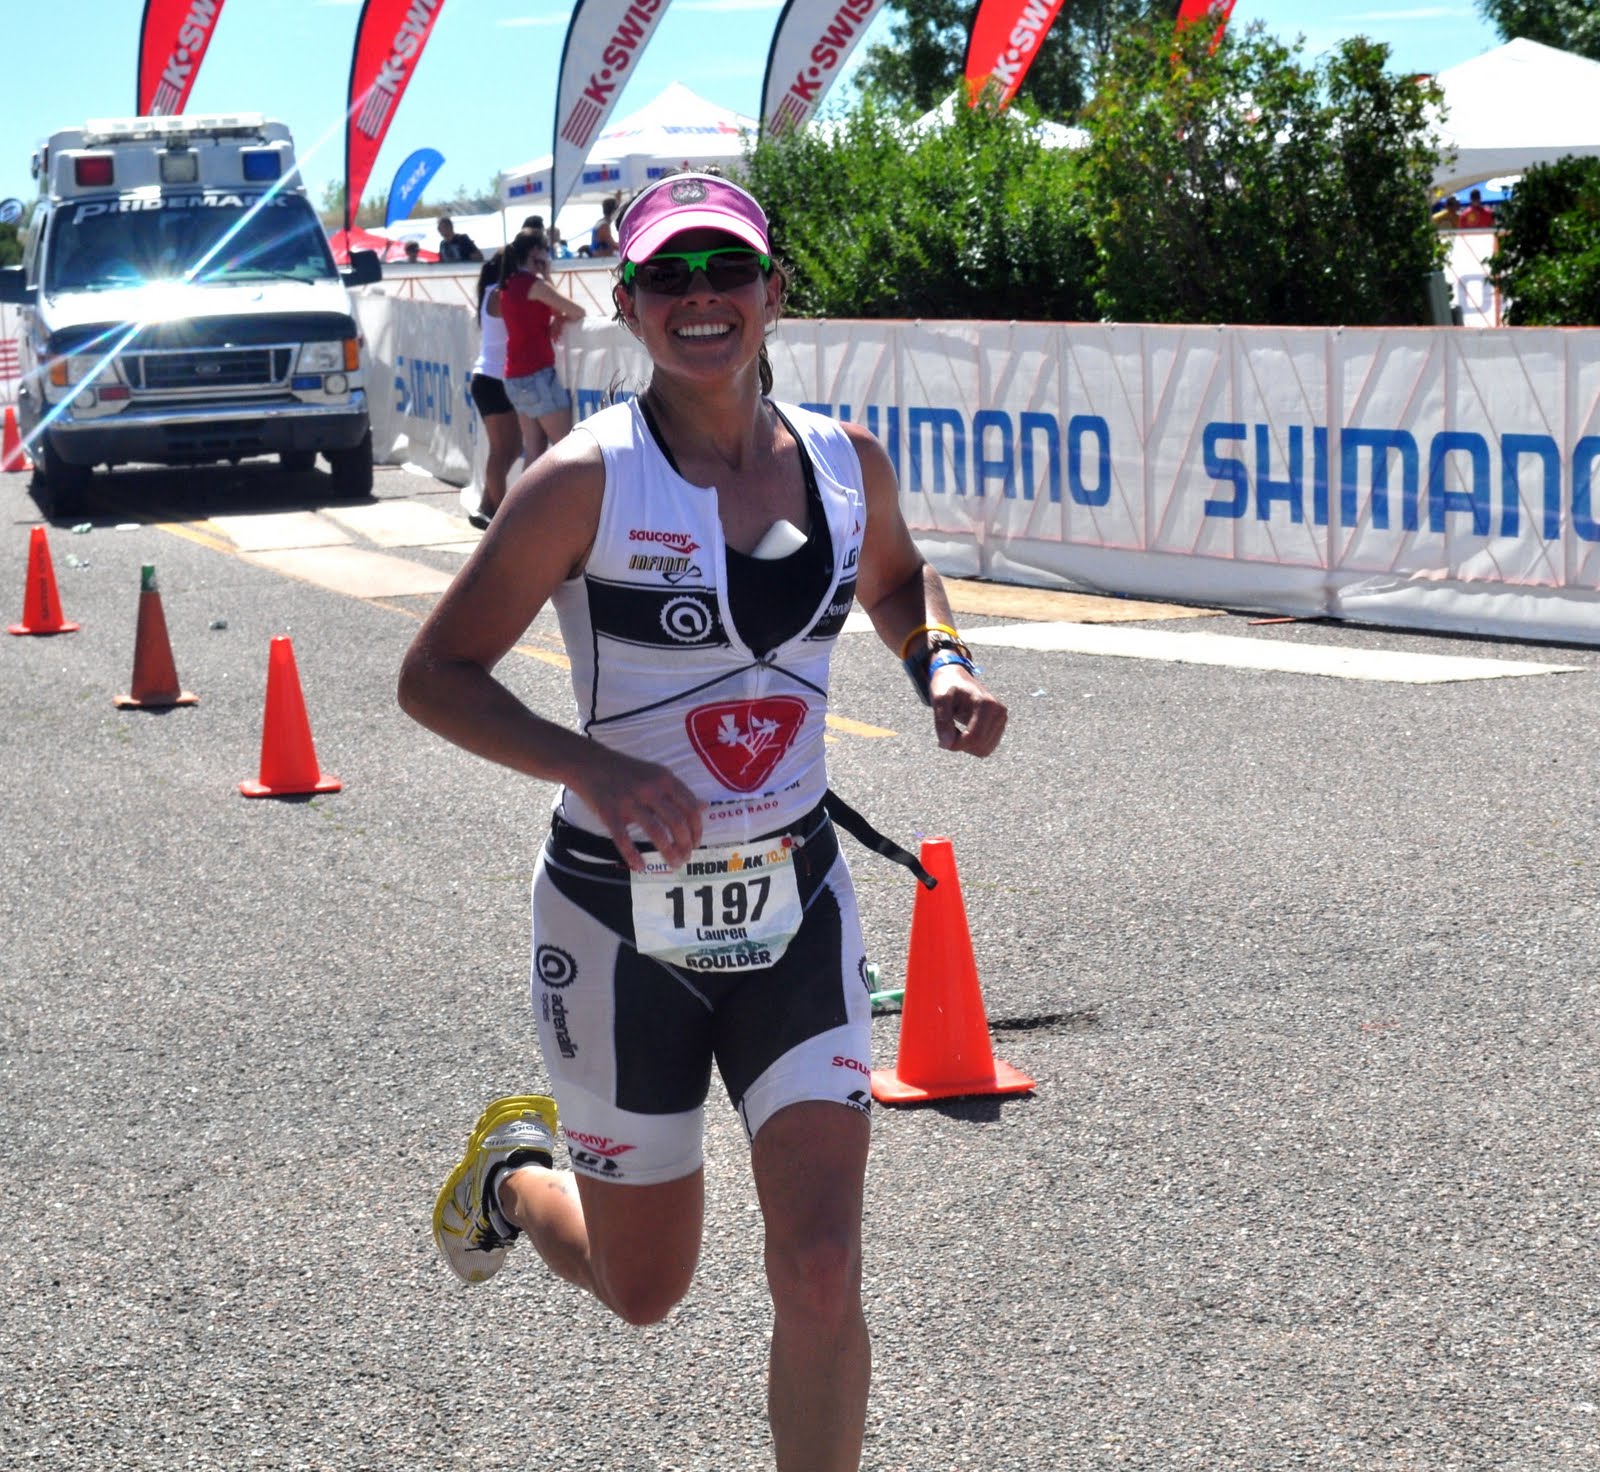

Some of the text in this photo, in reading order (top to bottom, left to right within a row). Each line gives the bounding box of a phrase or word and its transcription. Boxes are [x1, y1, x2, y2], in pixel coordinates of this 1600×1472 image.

[72, 195, 288, 225] PRIDEMARK
[799, 403, 1110, 506] IMANO
[629, 529, 688, 546] saucony
[665, 876, 771, 929] 1197
[696, 926, 748, 941] Lauren
[685, 950, 772, 970] BOULDER
